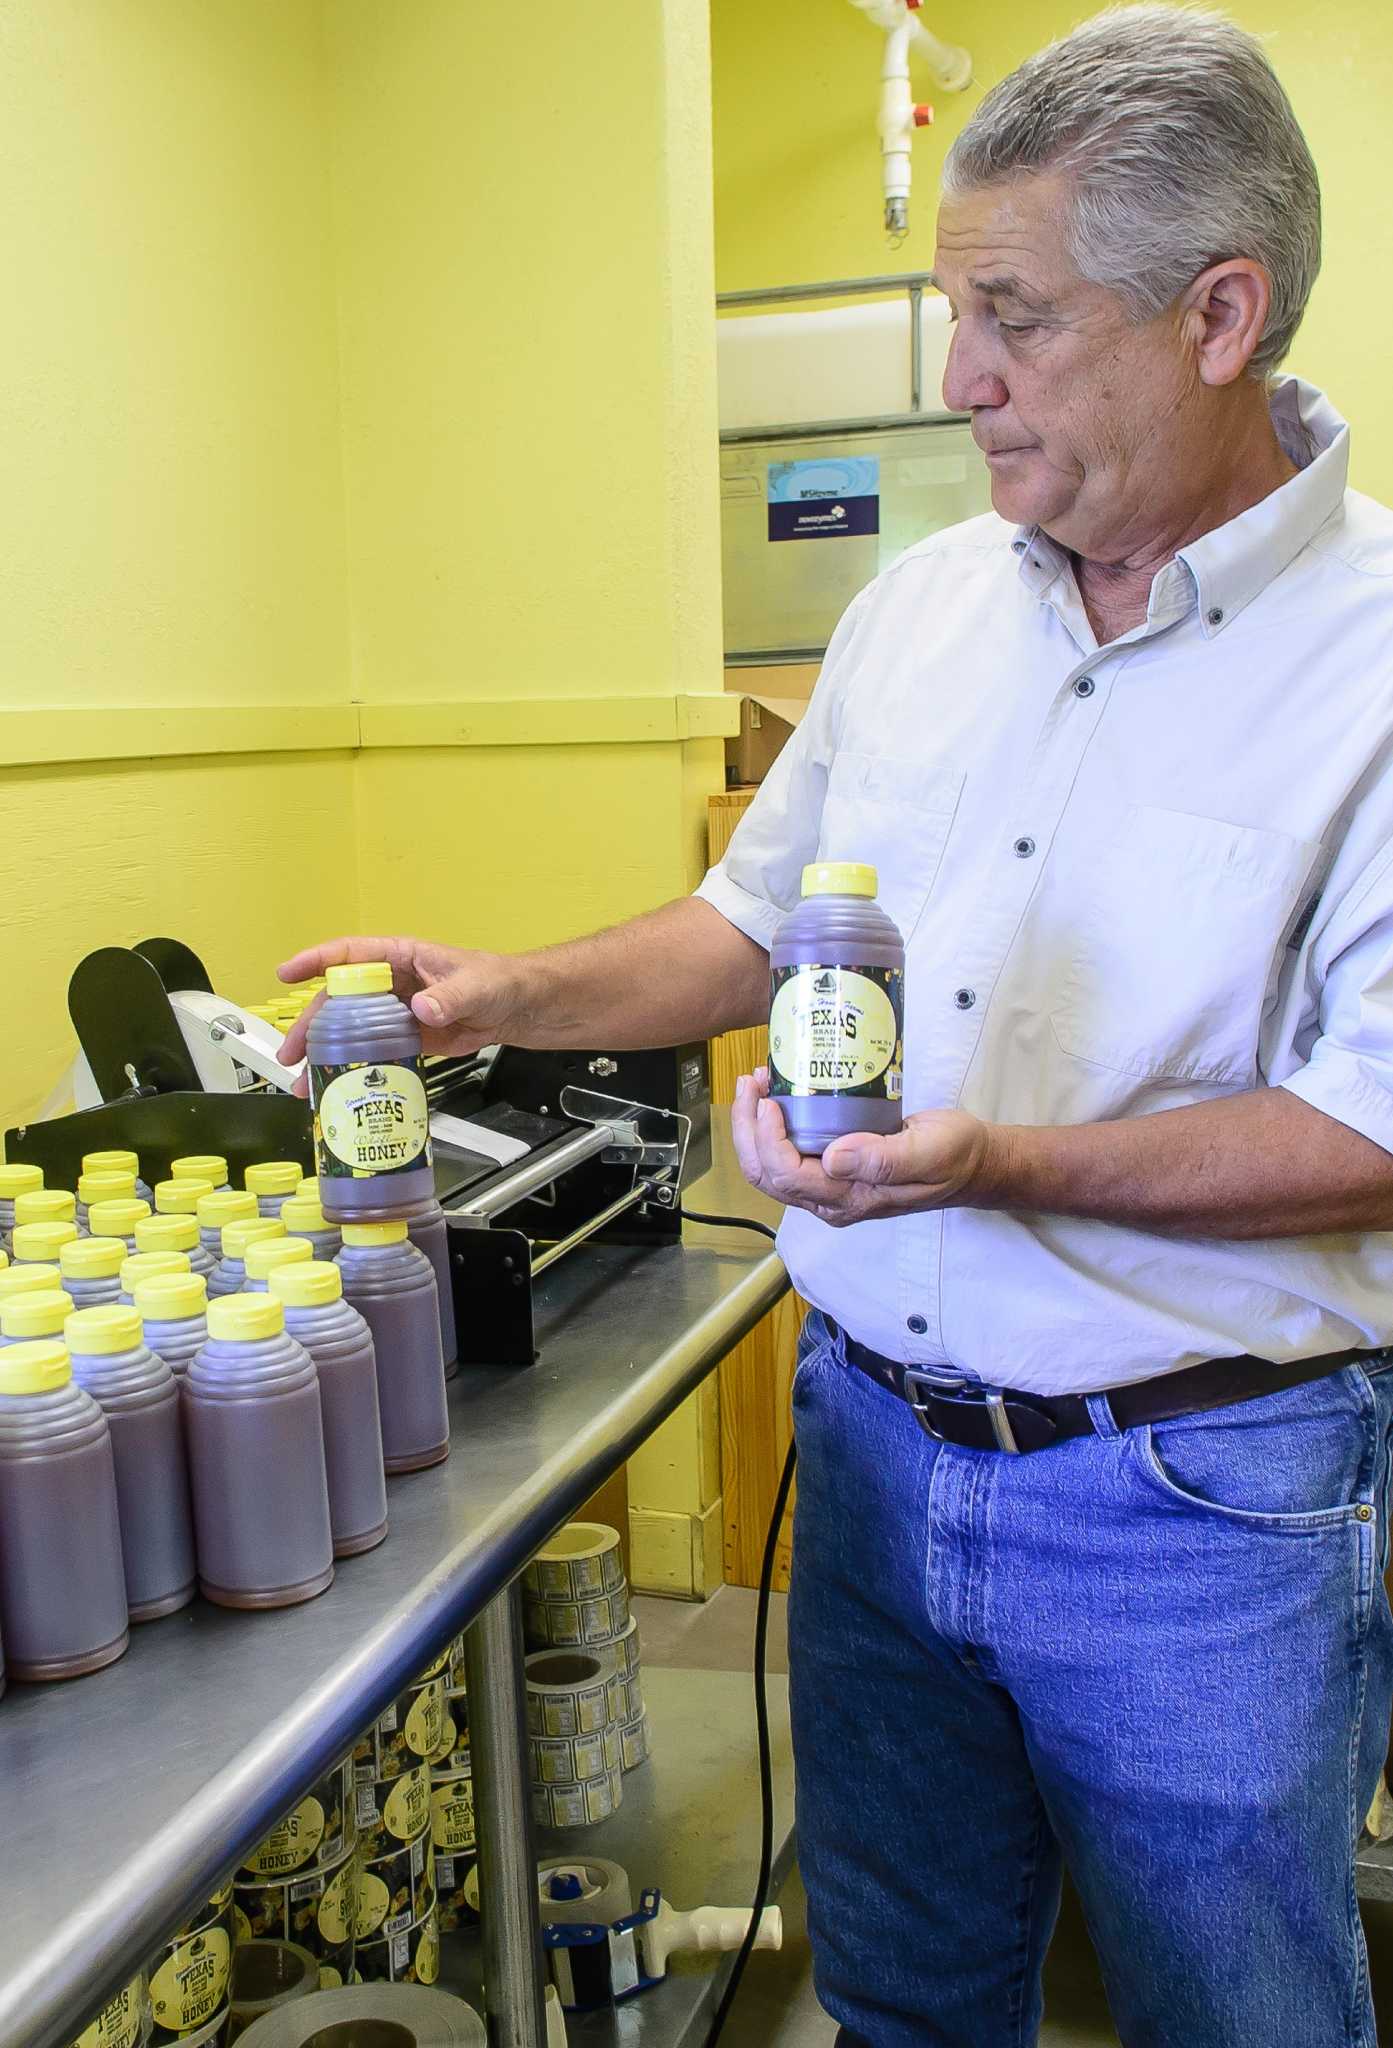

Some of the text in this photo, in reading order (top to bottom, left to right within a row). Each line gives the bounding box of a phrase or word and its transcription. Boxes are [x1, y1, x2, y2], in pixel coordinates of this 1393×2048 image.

[813, 1028, 842, 1036] BRAN
[809, 1060, 857, 1078] ONEY
[353, 1099, 405, 1128] TEXAS
[358, 1142, 407, 1162] HONEY
[446, 1830, 473, 1845] HONE
[260, 1851, 298, 1870] HONEY
[180, 1959, 215, 1995] TEXAS
[182, 1992, 217, 2026] HONEY
